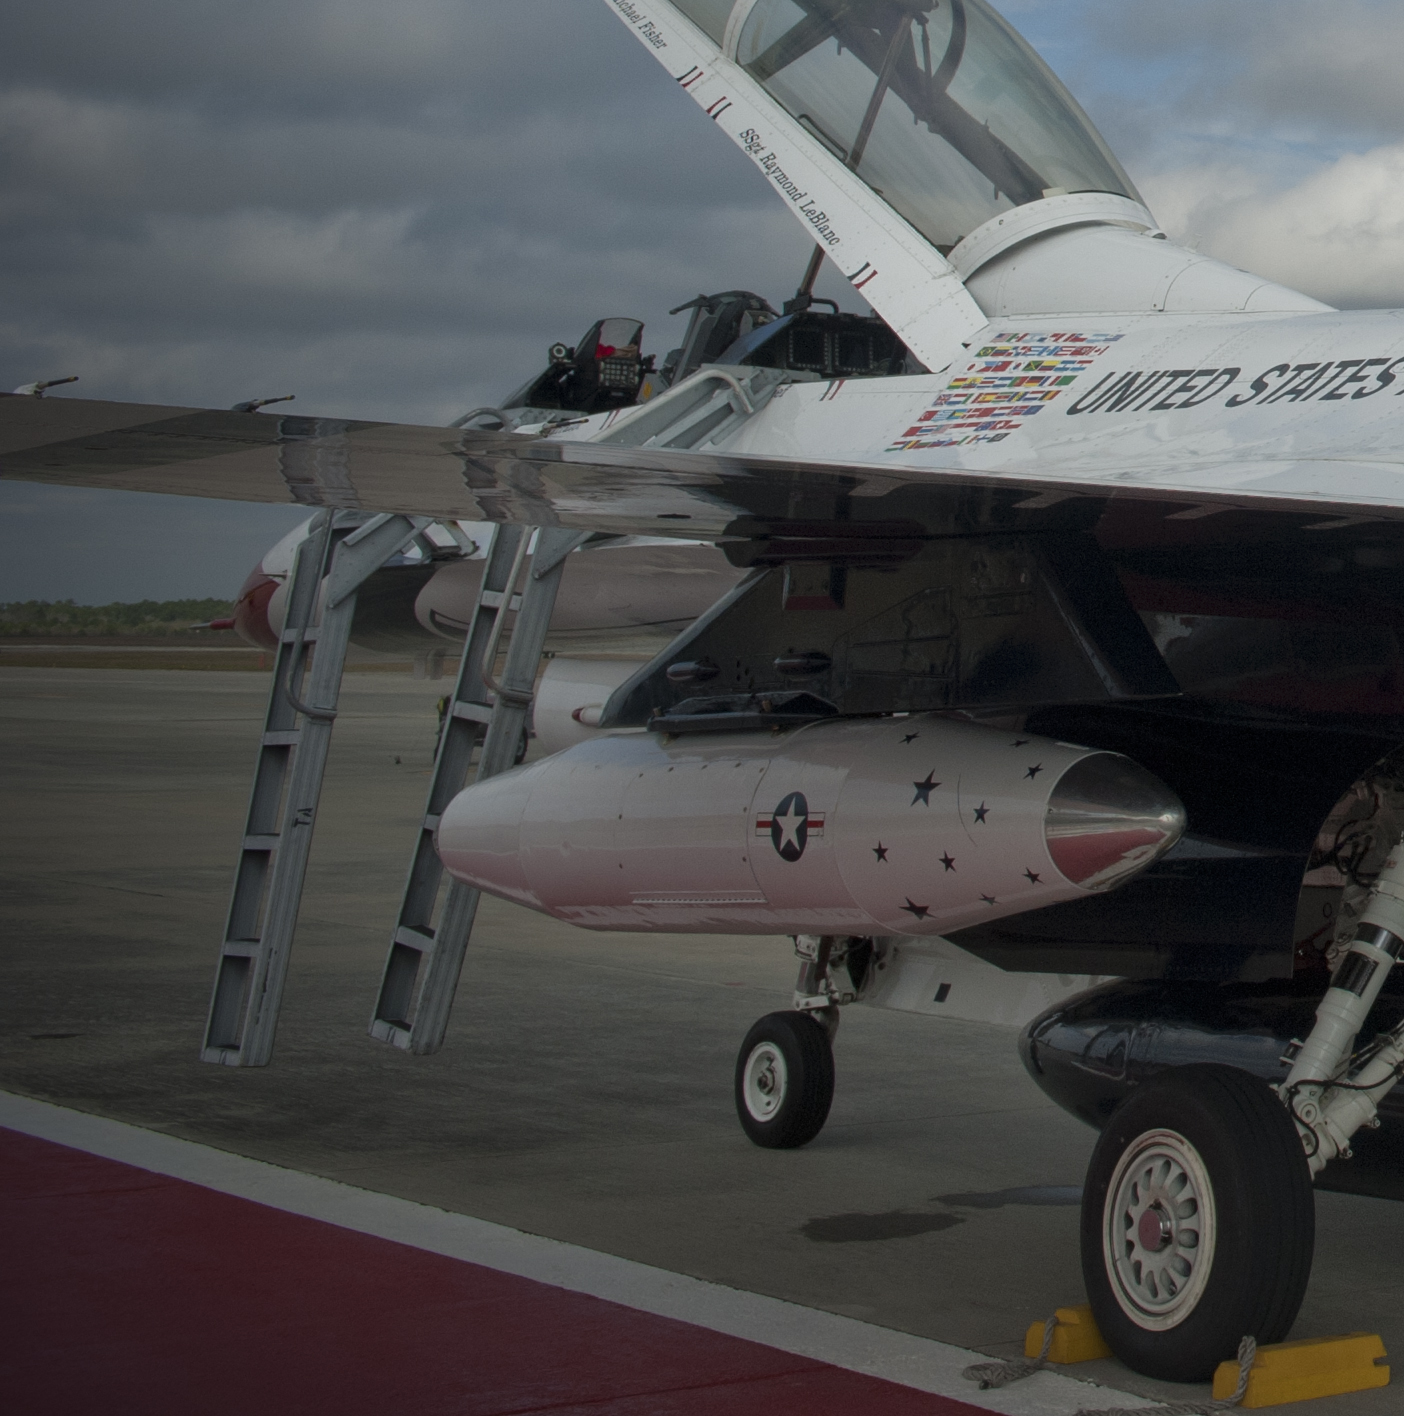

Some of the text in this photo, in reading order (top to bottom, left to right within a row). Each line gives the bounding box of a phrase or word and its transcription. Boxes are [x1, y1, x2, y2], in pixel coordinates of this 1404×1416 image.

[637, 21, 667, 51] Fisher
[739, 128, 840, 246] SSgt Raymond LeBlanc
[1066, 366, 1242, 416] UNITED
